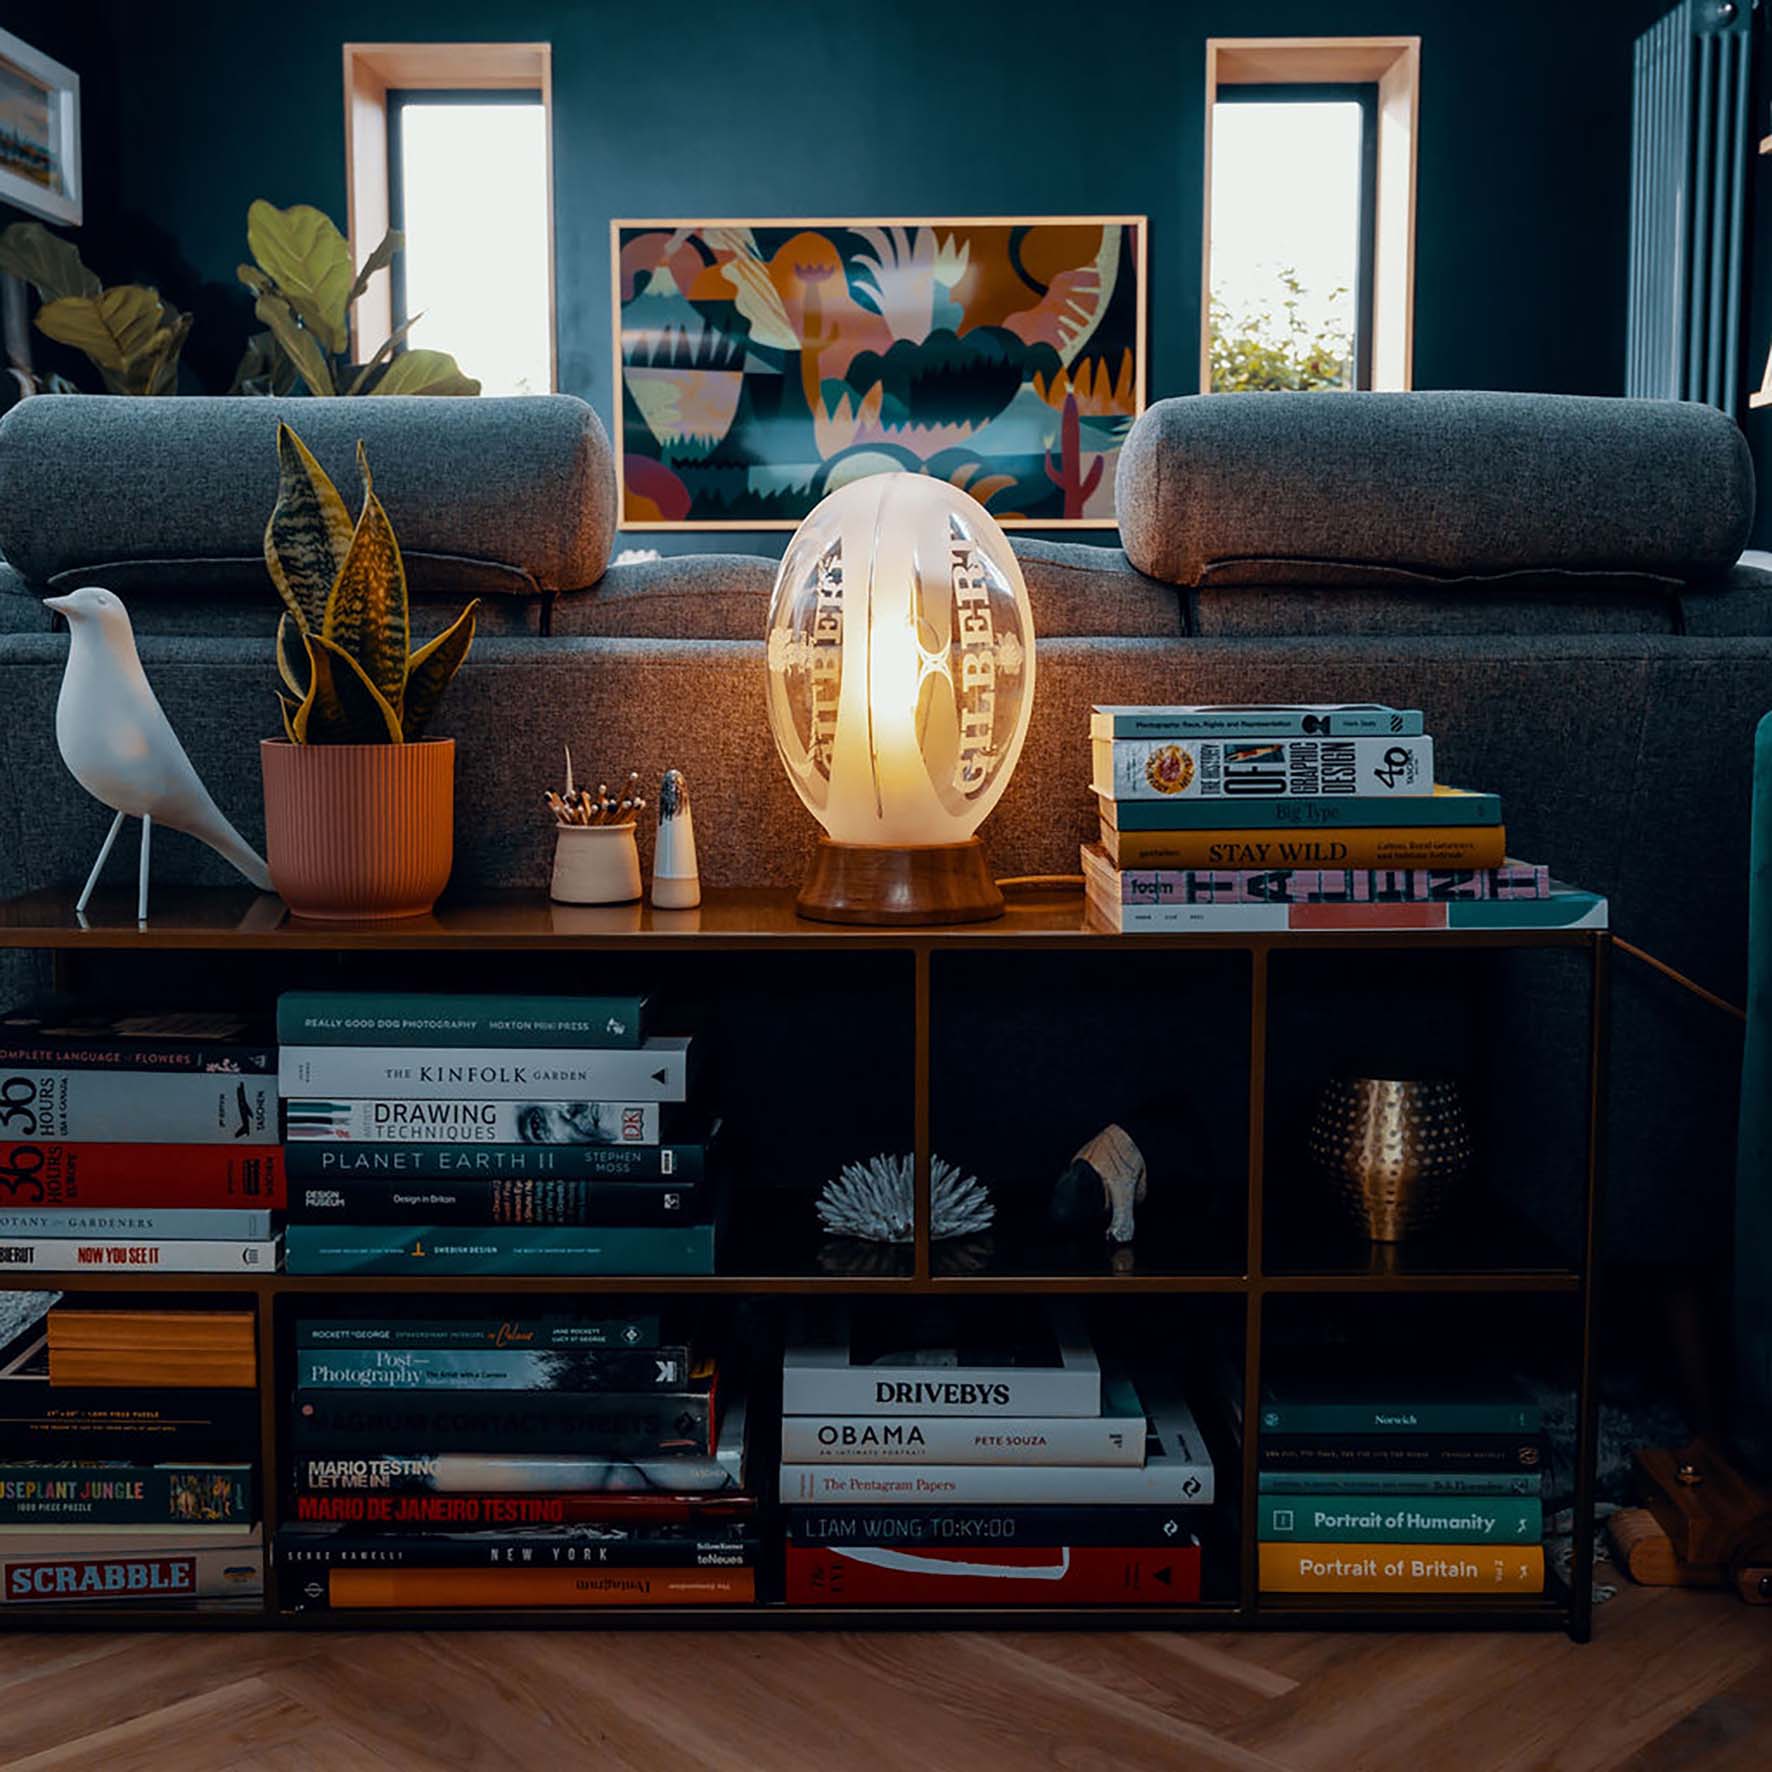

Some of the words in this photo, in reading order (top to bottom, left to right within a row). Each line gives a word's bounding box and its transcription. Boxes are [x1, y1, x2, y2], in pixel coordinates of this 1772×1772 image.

[948, 527, 995, 797] GILBERT
[1289, 742, 1319, 795] GRAPHIC
[1320, 741, 1357, 794] DESIGN
[1374, 747, 1409, 789] 40
[1223, 765, 1287, 795] OF
[1273, 803, 1301, 822] Big
[1305, 803, 1338, 822] Type
[1208, 842, 1273, 864] STAY
[1278, 842, 1349, 863] WILD
[1130, 879, 1175, 897] foam
[304, 1018, 342, 1028] REALLY
[344, 1018, 376, 1028] GOOD
[377, 1018, 401, 1029] DOG
[402, 1019, 477, 1030] PHOTOGRAPHY
[489, 1020, 532, 1031] HOXTON
[557, 1021, 590, 1032] PRESS
[0, 1049, 52, 1061] OMPLETE
[55, 1050, 121, 1063] LANGUAGE
[134, 1052, 192, 1064] FLOWERS
[385, 1068, 412, 1079] THE
[420, 1066, 528, 1083] KINFOLK
[533, 1070, 587, 1082] GARDEN
[39, 1077, 56, 1137] HOURS
[256, 1090, 266, 1131] TASCHEN
[374, 1103, 497, 1125] DRAWING
[375, 1126, 496, 1141] TECHNIQUES
[622, 1110, 642, 1141] DK
[321, 1152, 424, 1170] PLANET
[439, 1152, 527, 1170] EARTH
[538, 1152, 555, 1170] II
[583, 1150, 642, 1163] STEPHEN
[47, 1145, 63, 1204] HOURS
[595, 1162, 631, 1174] MOSS
[305, 1189, 340, 1199] DESIGN
[305, 1197, 346, 1208] MUSEUM
[392, 1194, 422, 1206] Design
[430, 1194, 457, 1205] Britain
[68, 1218, 154, 1229] GARDENERS
[77, 1246, 104, 1265] NOW
[106, 1247, 127, 1265] YOU
[129, 1247, 148, 1265] SEE
[149, 1246, 160, 1264] IT
[468, 1246, 499, 1255] DESIGN
[311, 1330, 351, 1340] ROCKETT
[356, 1330, 391, 1340] GEORGE
[551, 1335, 569, 1344] LUCY
[580, 1335, 607, 1344] GEORGE
[570, 1327, 601, 1335] ROCKETT
[311, 1365, 422, 1387] Photography
[875, 1382, 1010, 1406] DRIVEBYS
[1374, 1415, 1418, 1425] Norwich
[818, 1425, 926, 1446] OBAMA
[974, 1436, 1002, 1446] PETE
[1005, 1436, 1048, 1447] SOUZA
[308, 1460, 367, 1476] MARIO
[367, 1460, 442, 1476] TESTINO
[79, 1481, 145, 1501] JUNGLE
[308, 1475, 340, 1489] LET
[341, 1475, 368, 1488] ME
[369, 1475, 390, 1489] IN!
[823, 1478, 847, 1492] The
[850, 1478, 913, 1493] Pentagram
[916, 1478, 956, 1494] Papers
[38, 1503, 62, 1513] PIECE
[62, 1503, 94, 1513] PUZZLE
[297, 1495, 364, 1522] MARIO
[367, 1496, 393, 1521] DE
[394, 1496, 480, 1522] JANEIRO
[482, 1497, 565, 1522] TESTINO
[805, 1518, 857, 1538] LIAM
[862, 1518, 923, 1538] WONG
[1314, 1512, 1382, 1529] Portrait
[1385, 1512, 1406, 1529] of
[1407, 1513, 1496, 1534] Humanity
[490, 1547, 534, 1561] NEW
[552, 1547, 609, 1561] YORK
[696, 1553, 745, 1566] teNeues
[11, 1561, 192, 1595] SCRABBLE
[1299, 1559, 1378, 1578] Portrait
[1383, 1559, 1405, 1577] of
[1411, 1560, 1479, 1579] Britain
